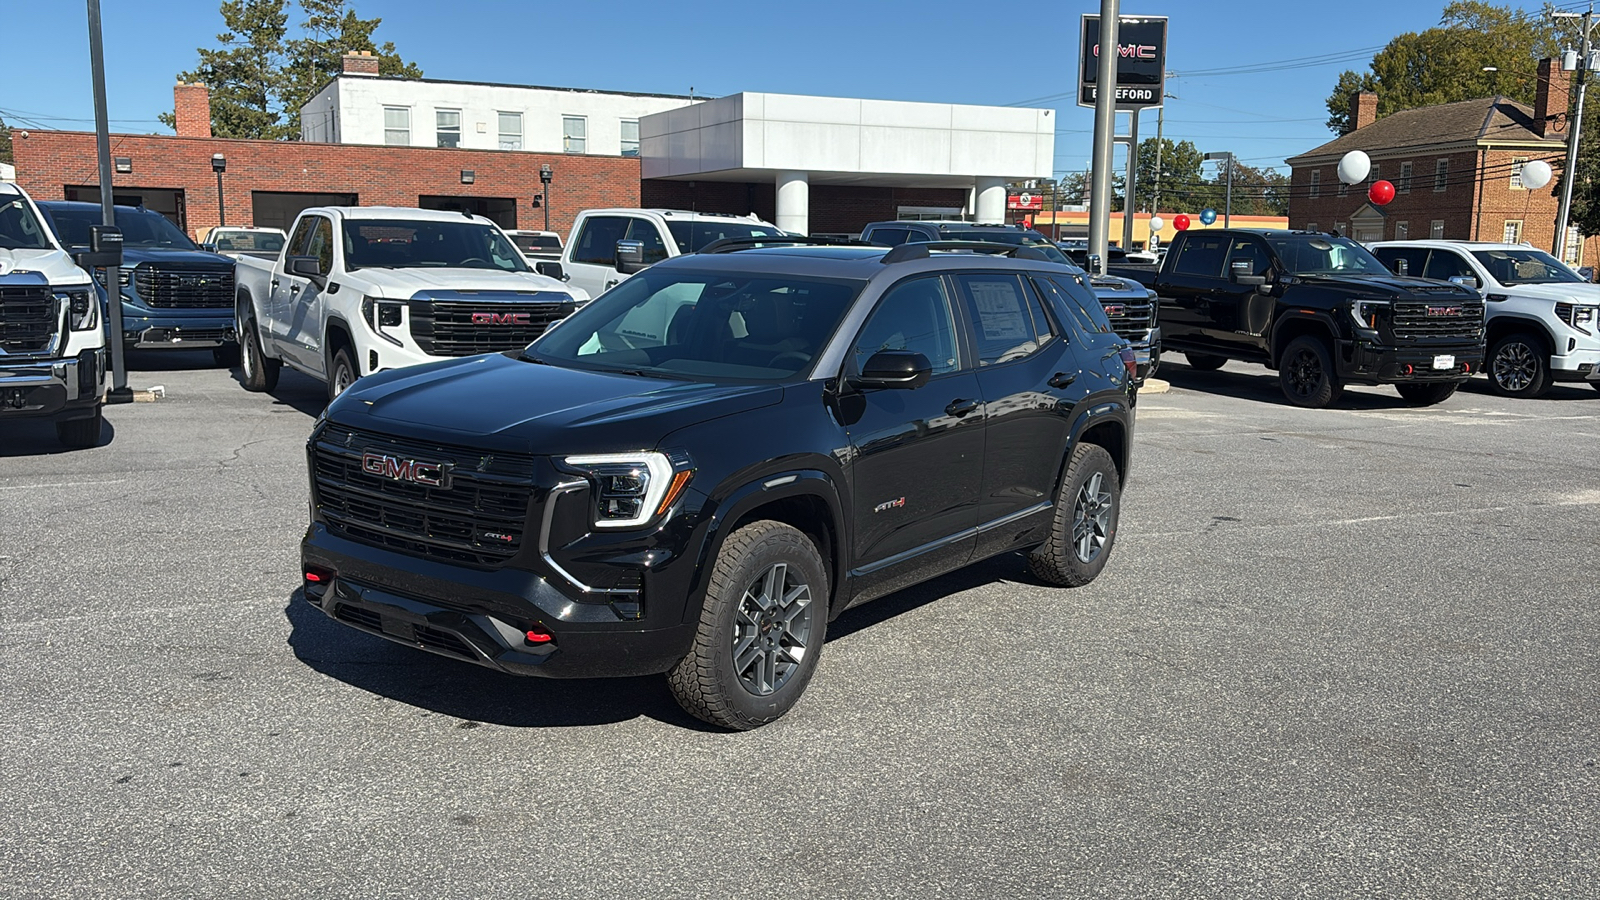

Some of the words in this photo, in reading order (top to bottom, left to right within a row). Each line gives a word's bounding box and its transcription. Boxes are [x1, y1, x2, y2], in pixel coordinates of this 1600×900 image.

[1093, 43, 1157, 58] MC
[1092, 89, 1152, 100] EFORD
[1428, 306, 1463, 316] GMC
[471, 312, 530, 325] GMC
[362, 452, 443, 487] GMC
[874, 496, 906, 513] AT4
[484, 531, 513, 542] AT4
